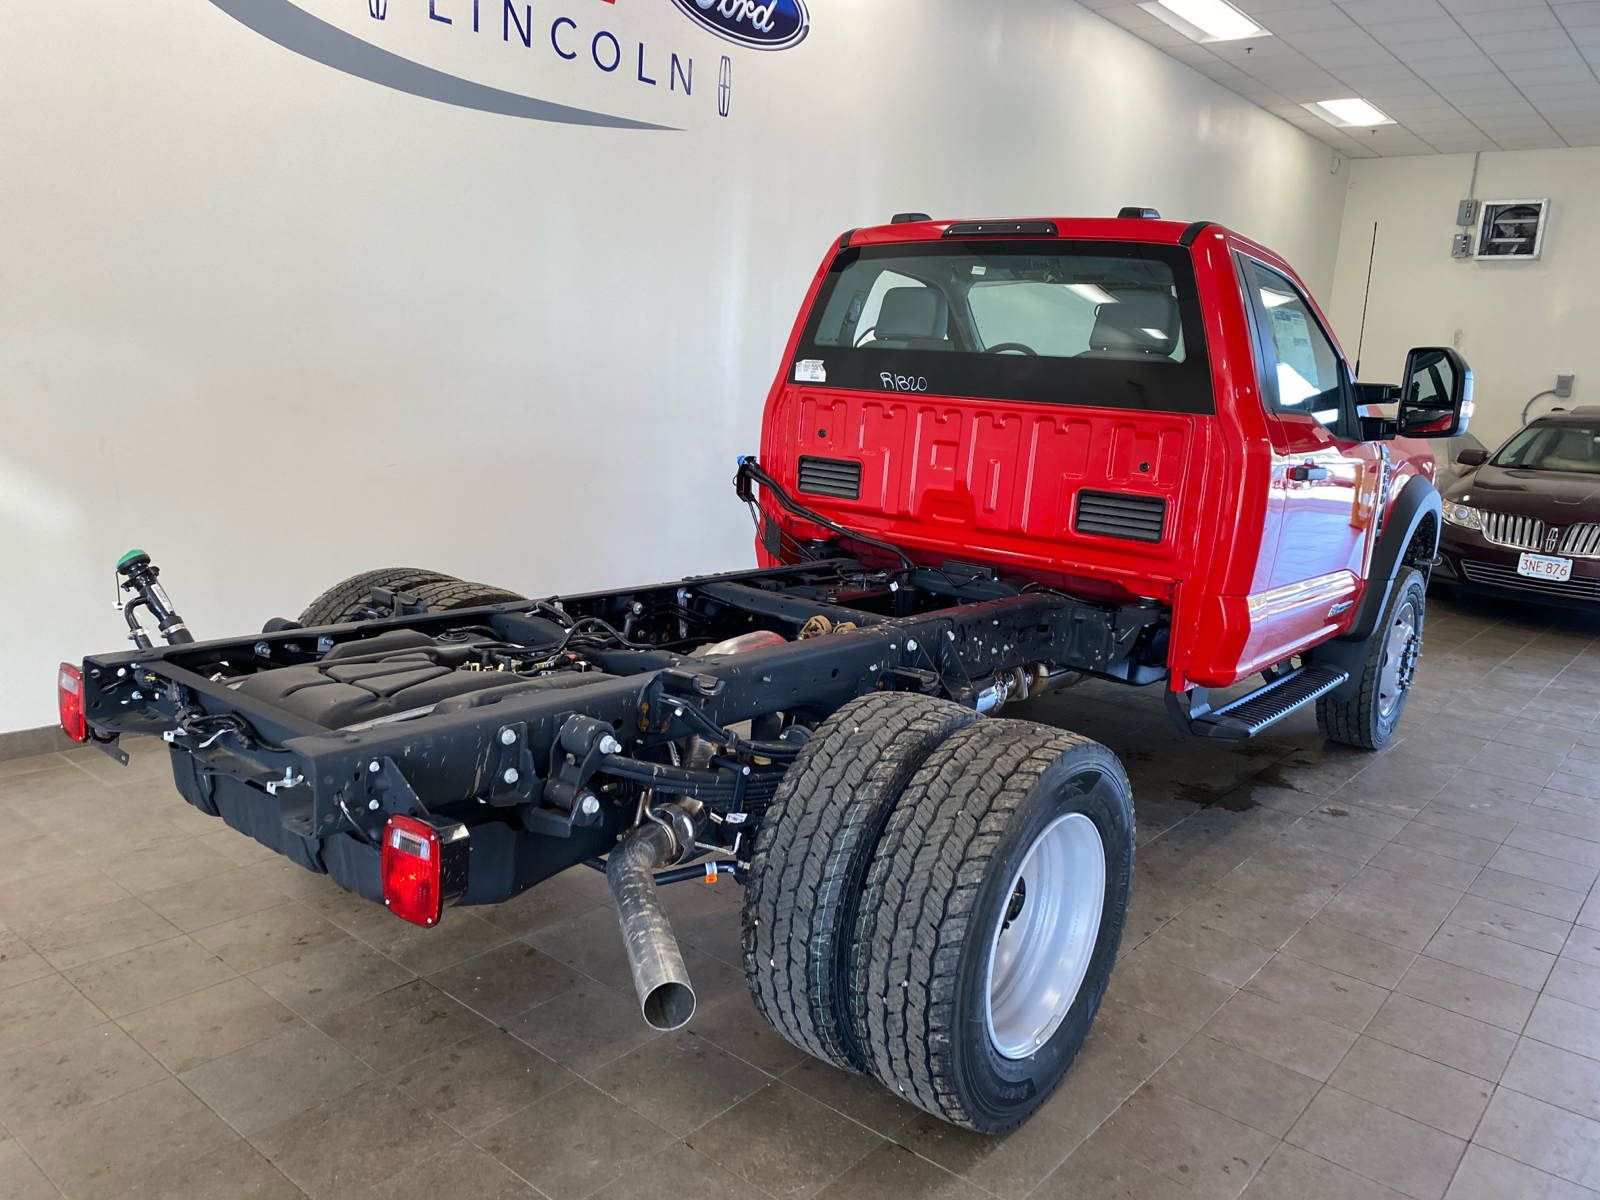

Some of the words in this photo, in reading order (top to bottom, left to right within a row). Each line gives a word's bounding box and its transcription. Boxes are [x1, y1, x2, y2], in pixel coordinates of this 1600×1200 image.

[695, 0, 775, 33] ord
[429, 0, 693, 96] LINCOLN
[1521, 558, 1543, 573] 3NE
[1545, 562, 1568, 576] 876
